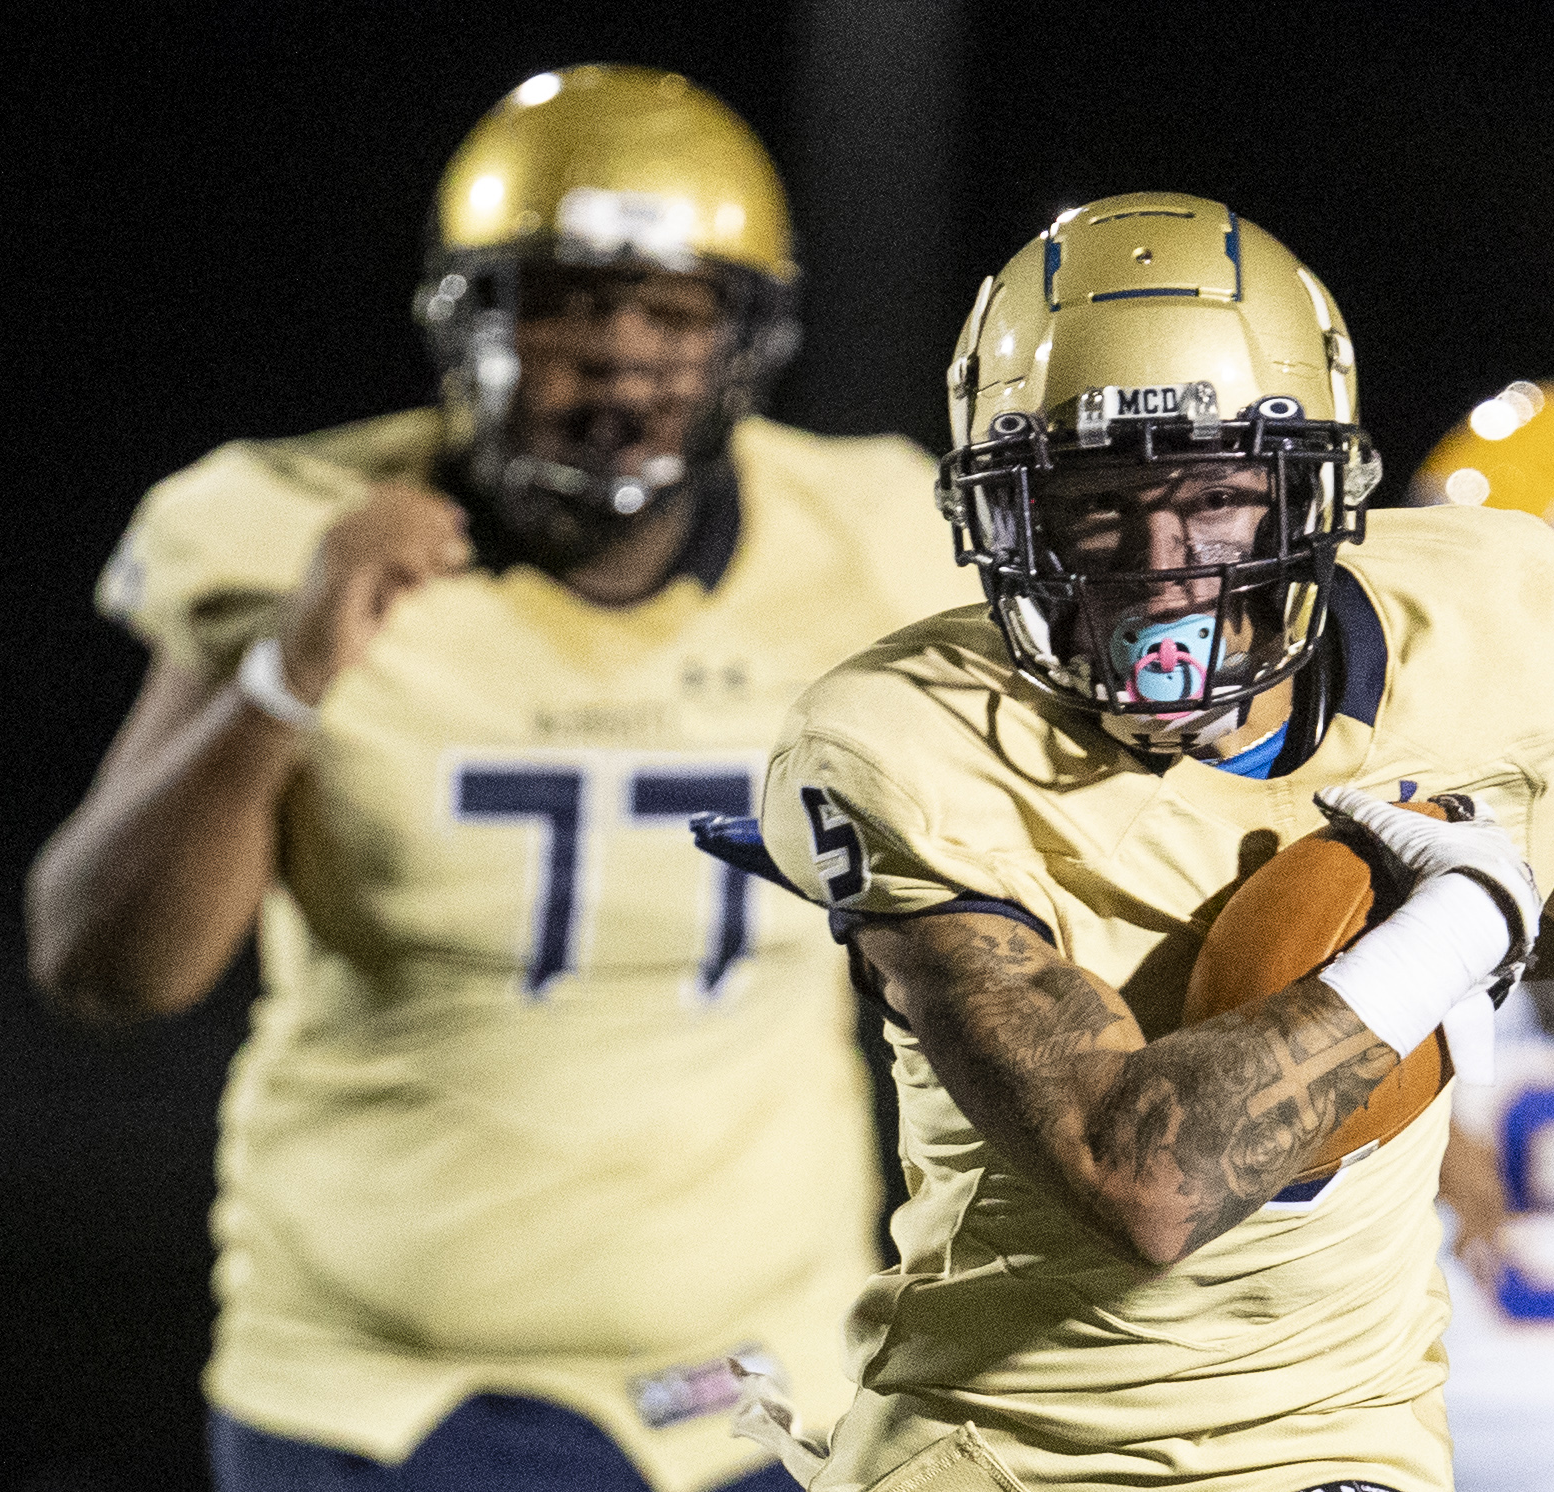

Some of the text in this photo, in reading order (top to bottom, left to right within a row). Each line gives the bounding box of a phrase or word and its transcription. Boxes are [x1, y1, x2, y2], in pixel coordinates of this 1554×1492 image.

[1118, 387, 1178, 415] MCD
[448, 748, 765, 1000] 77
[795, 777, 872, 906] 5
